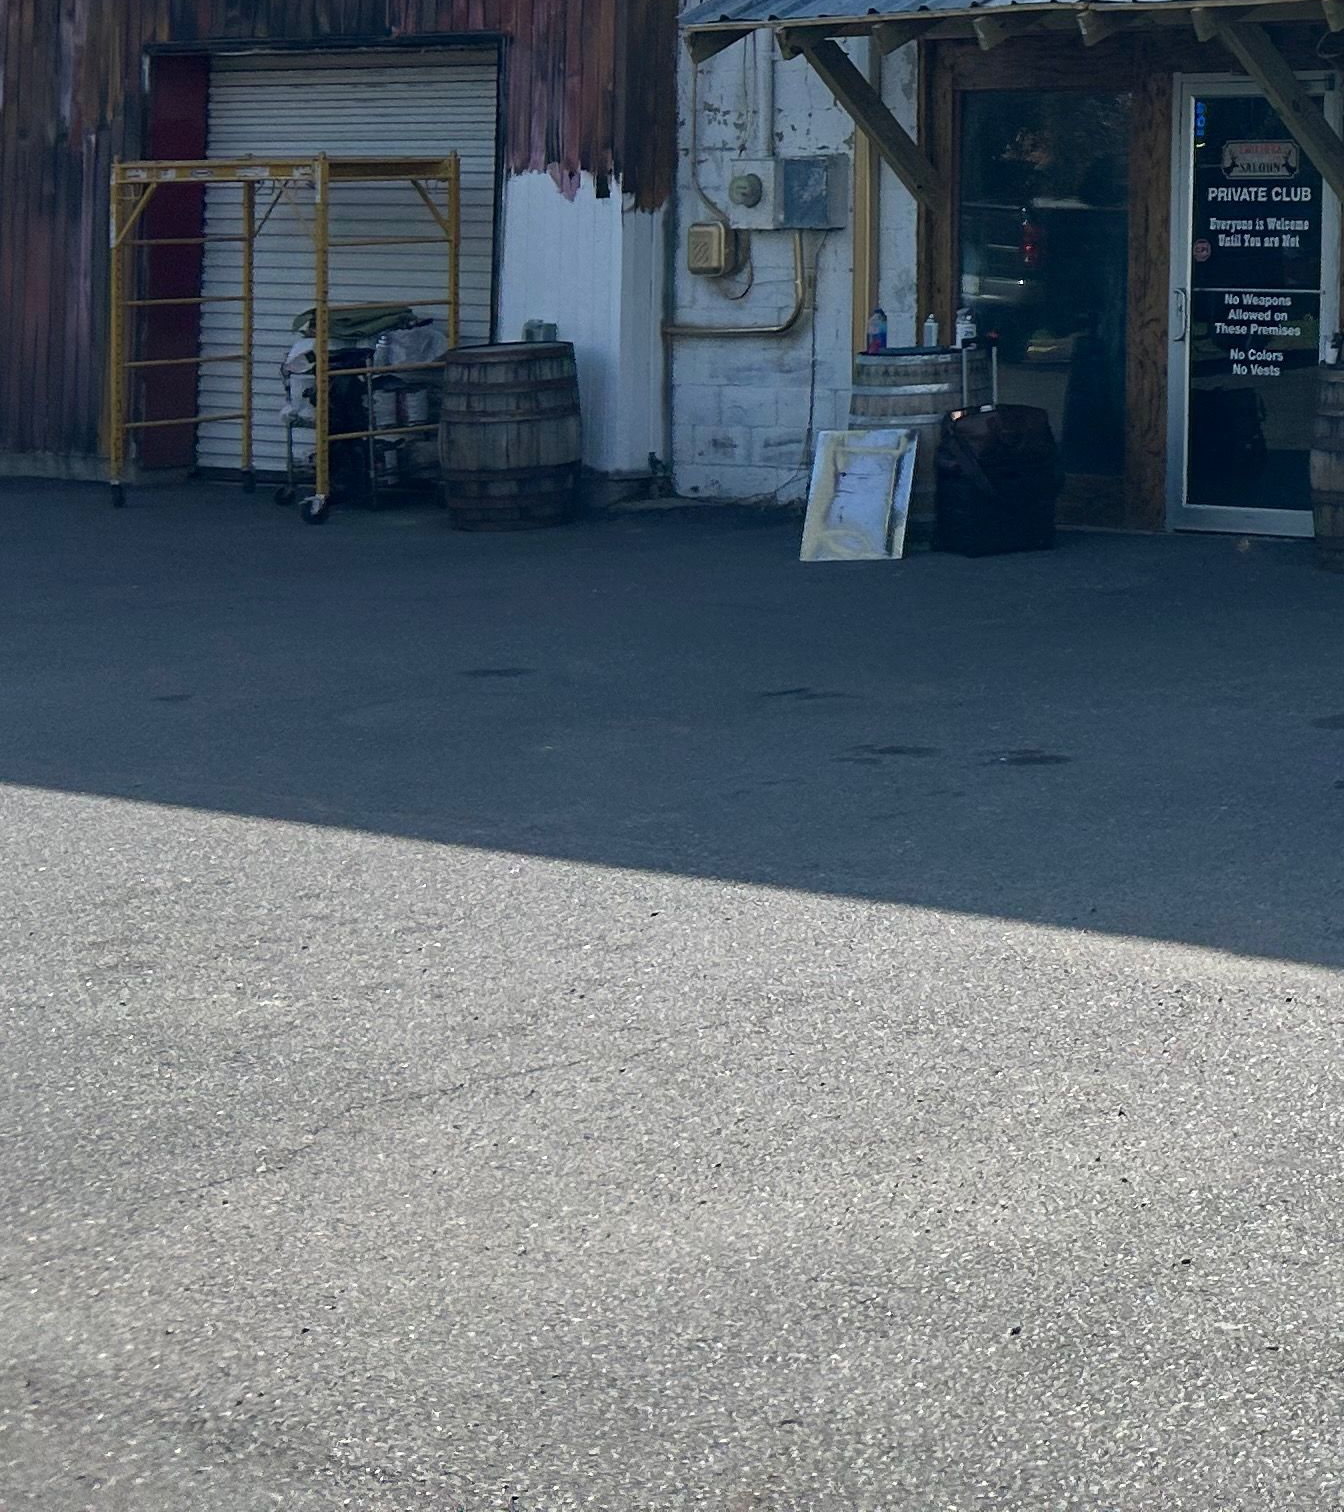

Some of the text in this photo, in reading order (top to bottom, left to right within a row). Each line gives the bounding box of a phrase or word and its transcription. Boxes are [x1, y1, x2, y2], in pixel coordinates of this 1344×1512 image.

[1208, 187, 1312, 202] PRIVATE CLUB
[1209, 218, 1309, 232] Everyone is Welcome
[1218, 234, 1300, 247] Until You are Not
[1224, 293, 1292, 307] No Weapons
[1228, 309, 1288, 321] Allowed on
[1215, 323, 1301, 336] These Premises
[1230, 348, 1283, 361] No Colors
[1232, 363, 1280, 376] No Vests
